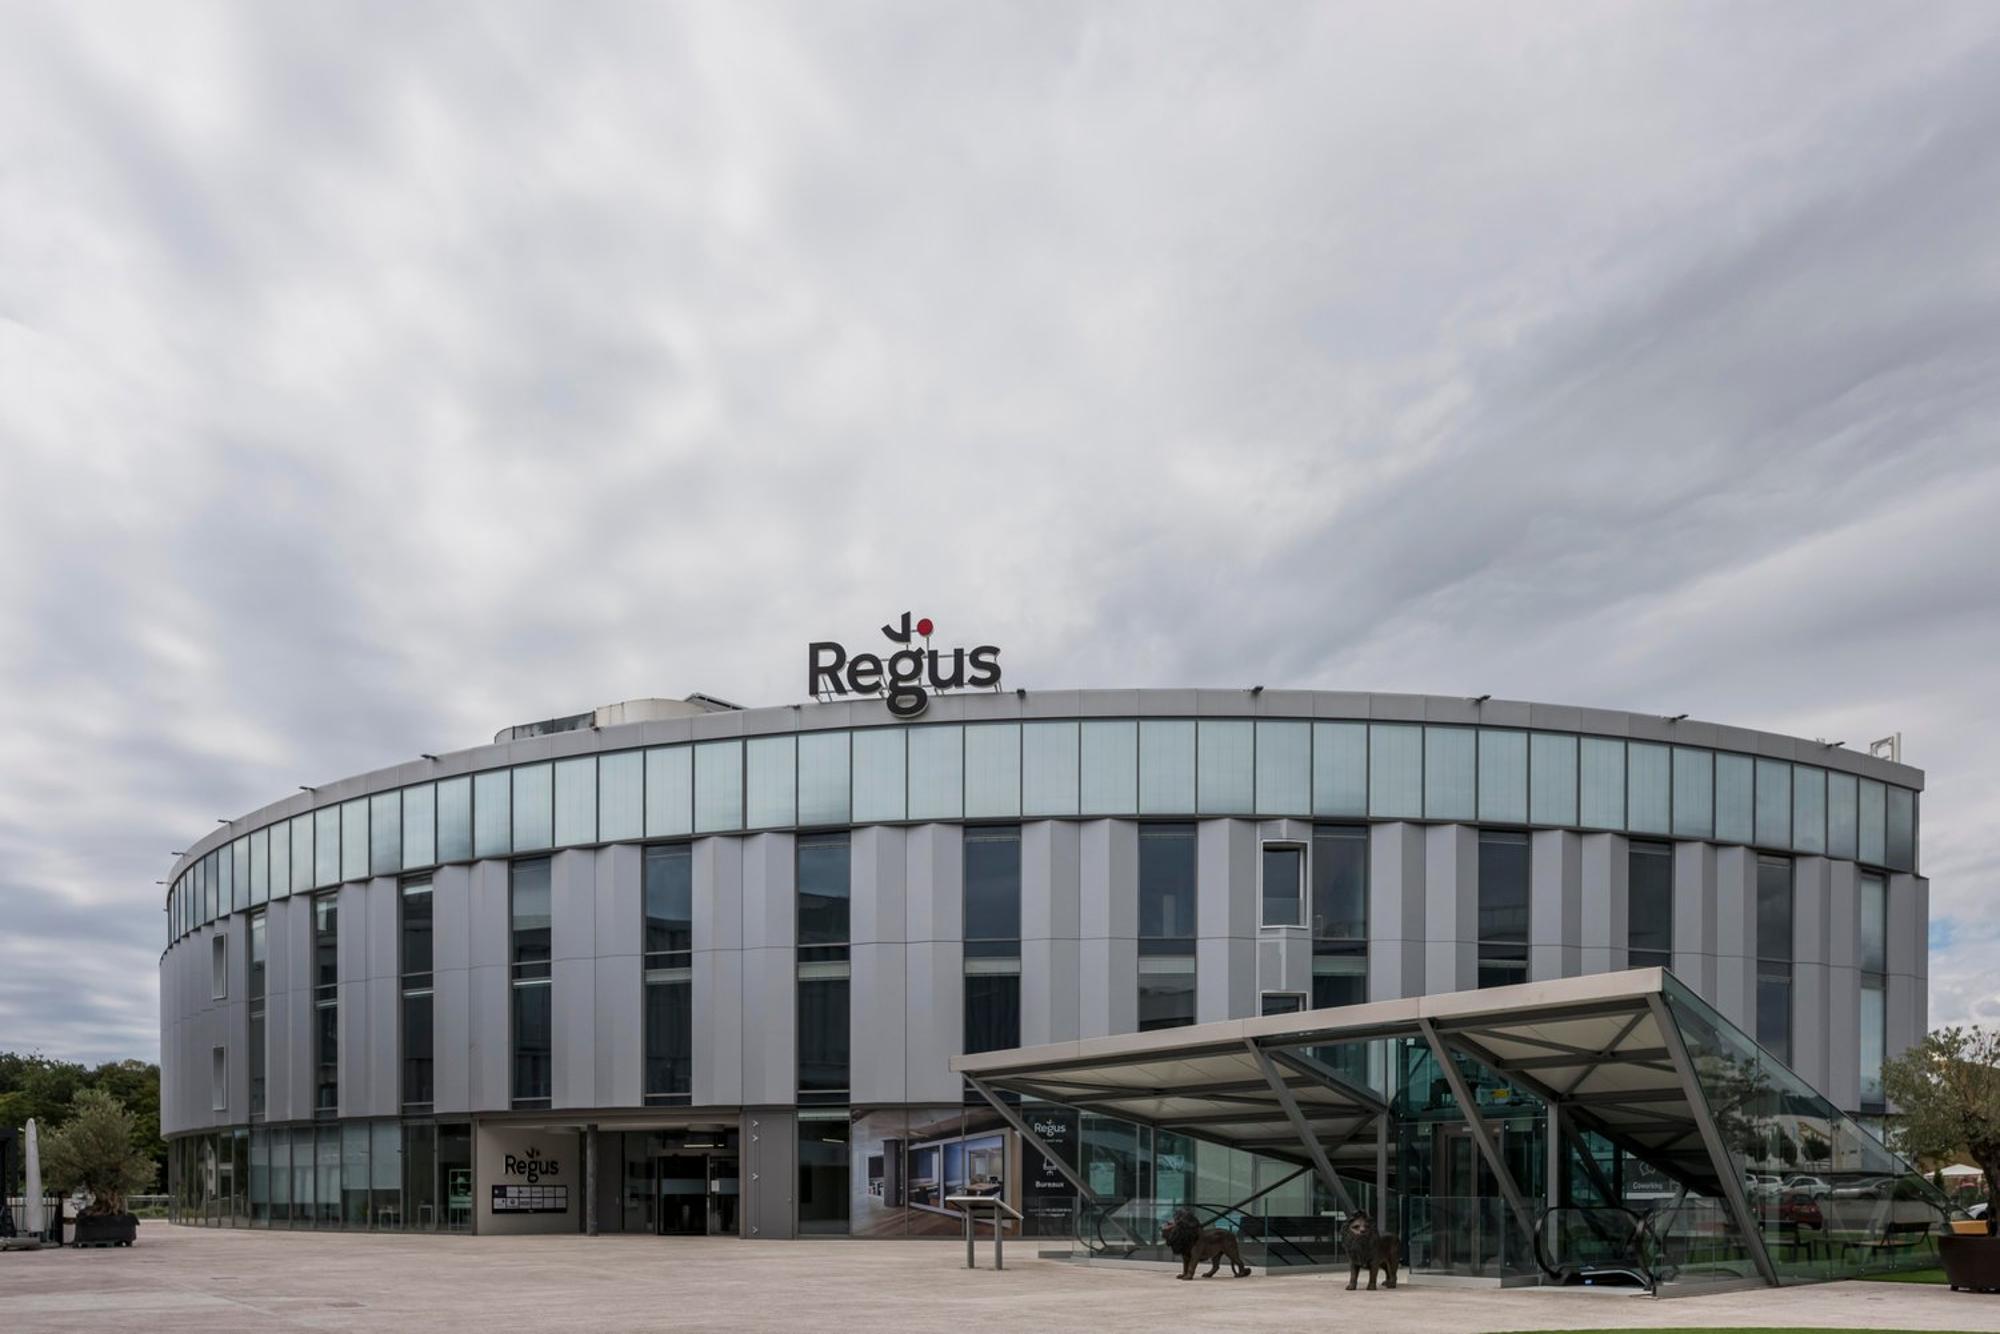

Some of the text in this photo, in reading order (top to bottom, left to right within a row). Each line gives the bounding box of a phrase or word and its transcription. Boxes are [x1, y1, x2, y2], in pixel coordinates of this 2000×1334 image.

[808, 640, 1001, 717] Regus
[1034, 1122, 1066, 1137] Regus
[505, 1154, 559, 1183] Regus
